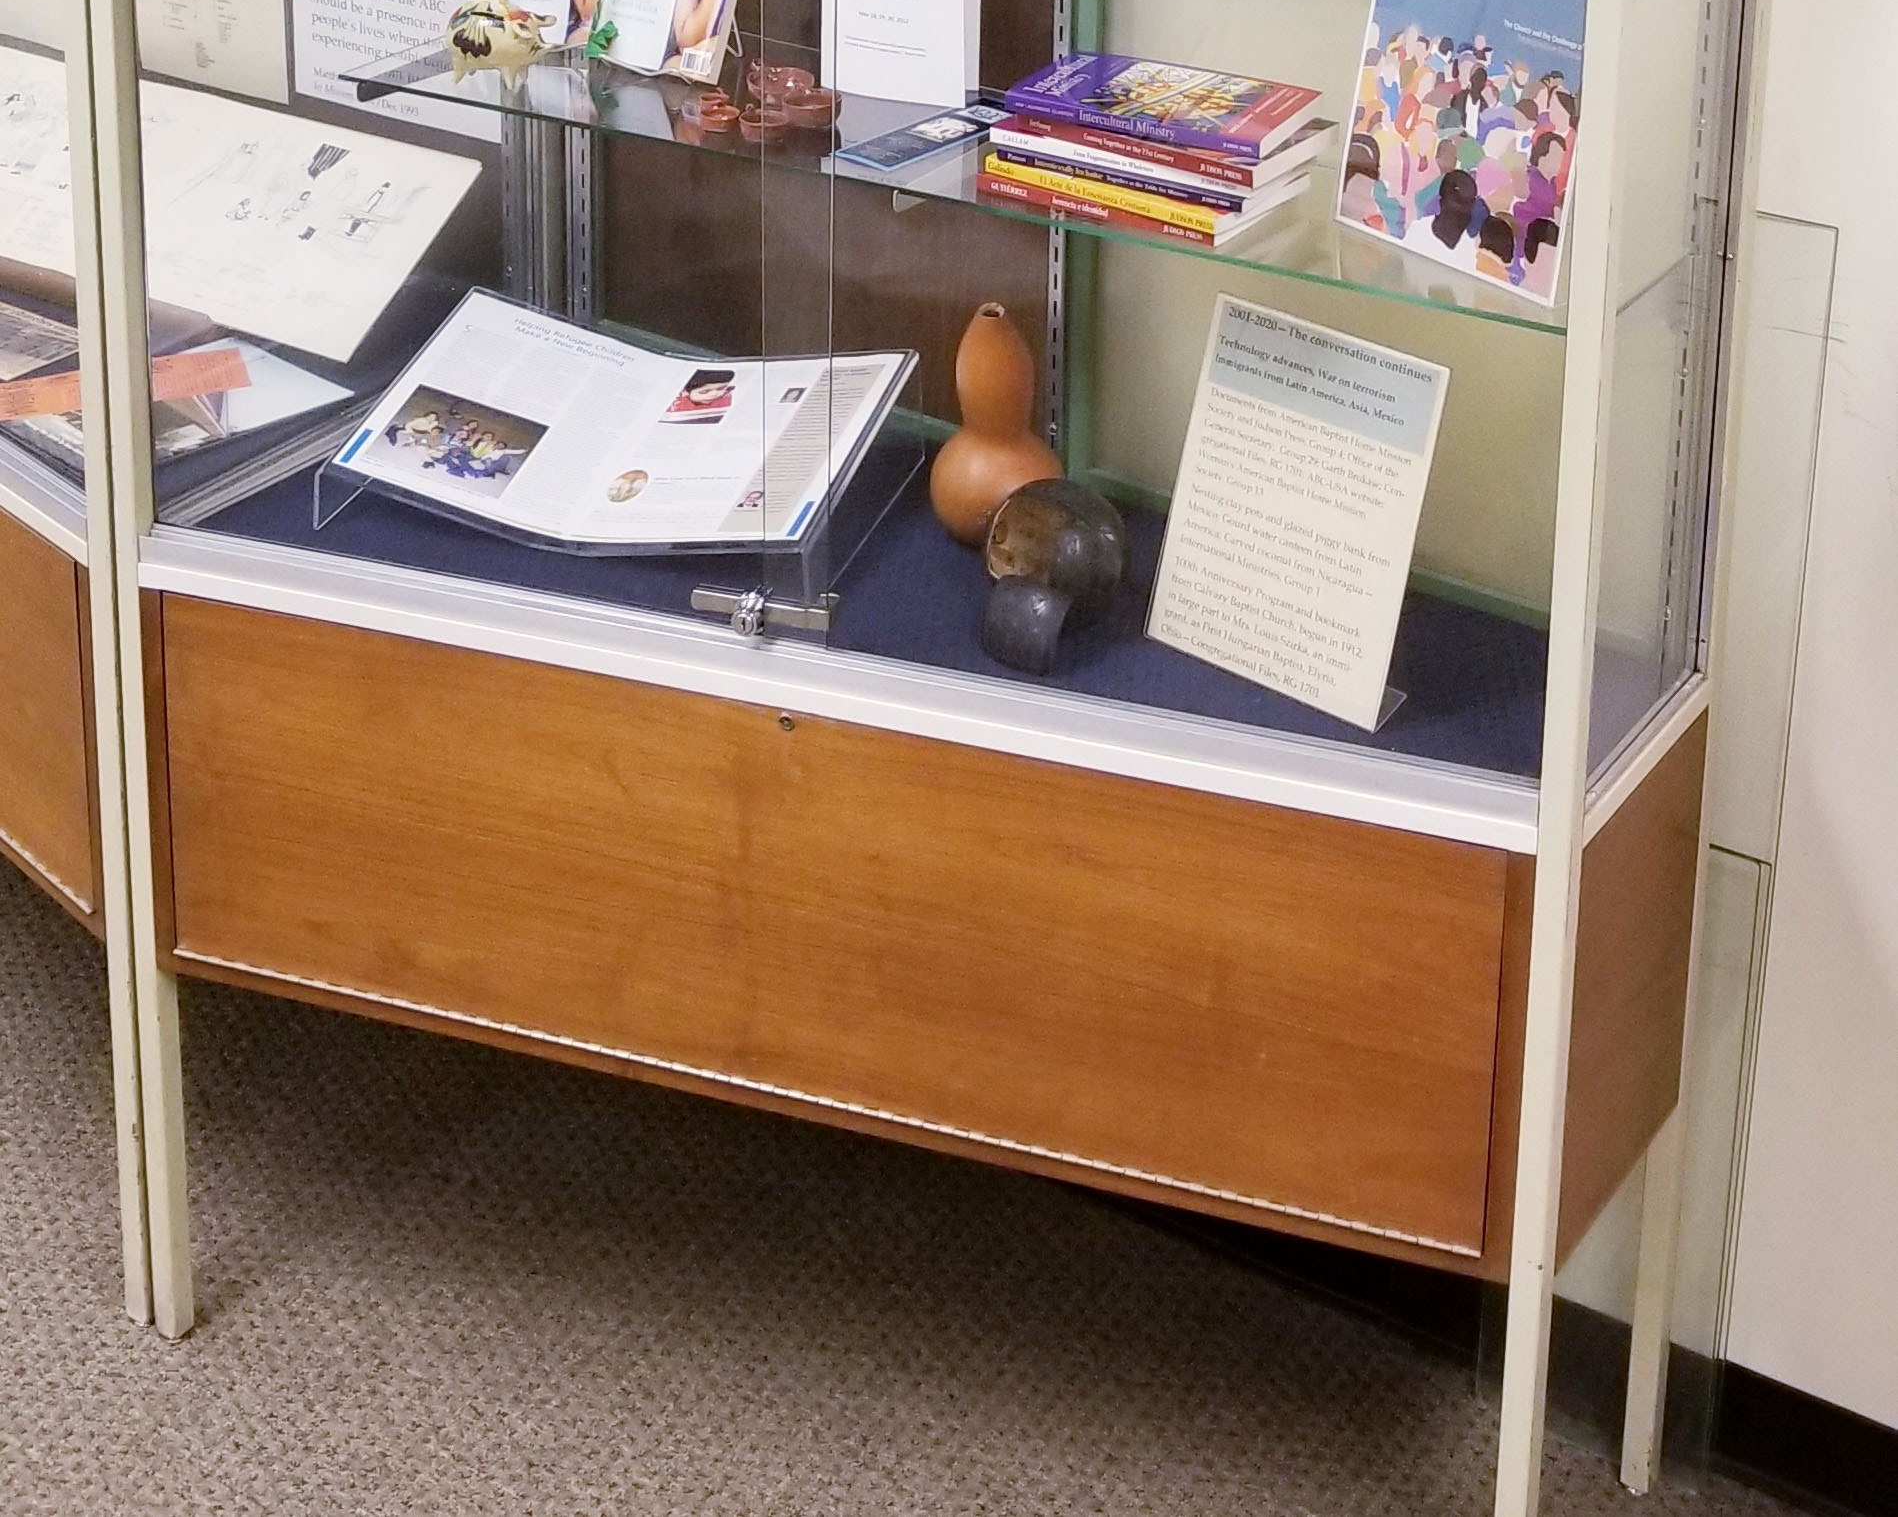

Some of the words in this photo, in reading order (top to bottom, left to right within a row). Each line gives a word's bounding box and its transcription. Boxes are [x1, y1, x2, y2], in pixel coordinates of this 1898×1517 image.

[351, 0, 363, 14] be
[367, 7, 372, 16] a
[376, 9, 429, 28] presence
[429, 19, 440, 31] in
[1079, 110, 1134, 132] Intercultural
[1135, 120, 1175, 140] Ministry
[515, 318, 550, 335] Helping
[553, 331, 593, 347] Refugee
[596, 344, 634, 362] Children
[515, 326, 541, 339] Make
[553, 338, 573, 349] New
[576, 346, 624, 367] Beginning
[1310, 335, 1377, 366] conversation
[1379, 359, 1433, 383] continues
[1215, 353, 1262, 379] Immigrants
[1263, 370, 1284, 385] from
[1286, 377, 1308, 394] Latin
[1310, 385, 1346, 408] America,
[1349, 400, 1369, 417] Asia,
[1372, 408, 1404, 427] Mexico
[1219, 335, 1271, 361] Technology
[1273, 353, 1315, 377] advances,
[1318, 367, 1336, 382] War
[1338, 376, 1350, 388] on
[1352, 380, 1396, 404] terrorism
[1201, 567, 1252, 595] Anniversary
[1256, 589, 1293, 611] Program
[1295, 606, 1312, 619] and
[1315, 612, 1360, 638] bookmark
